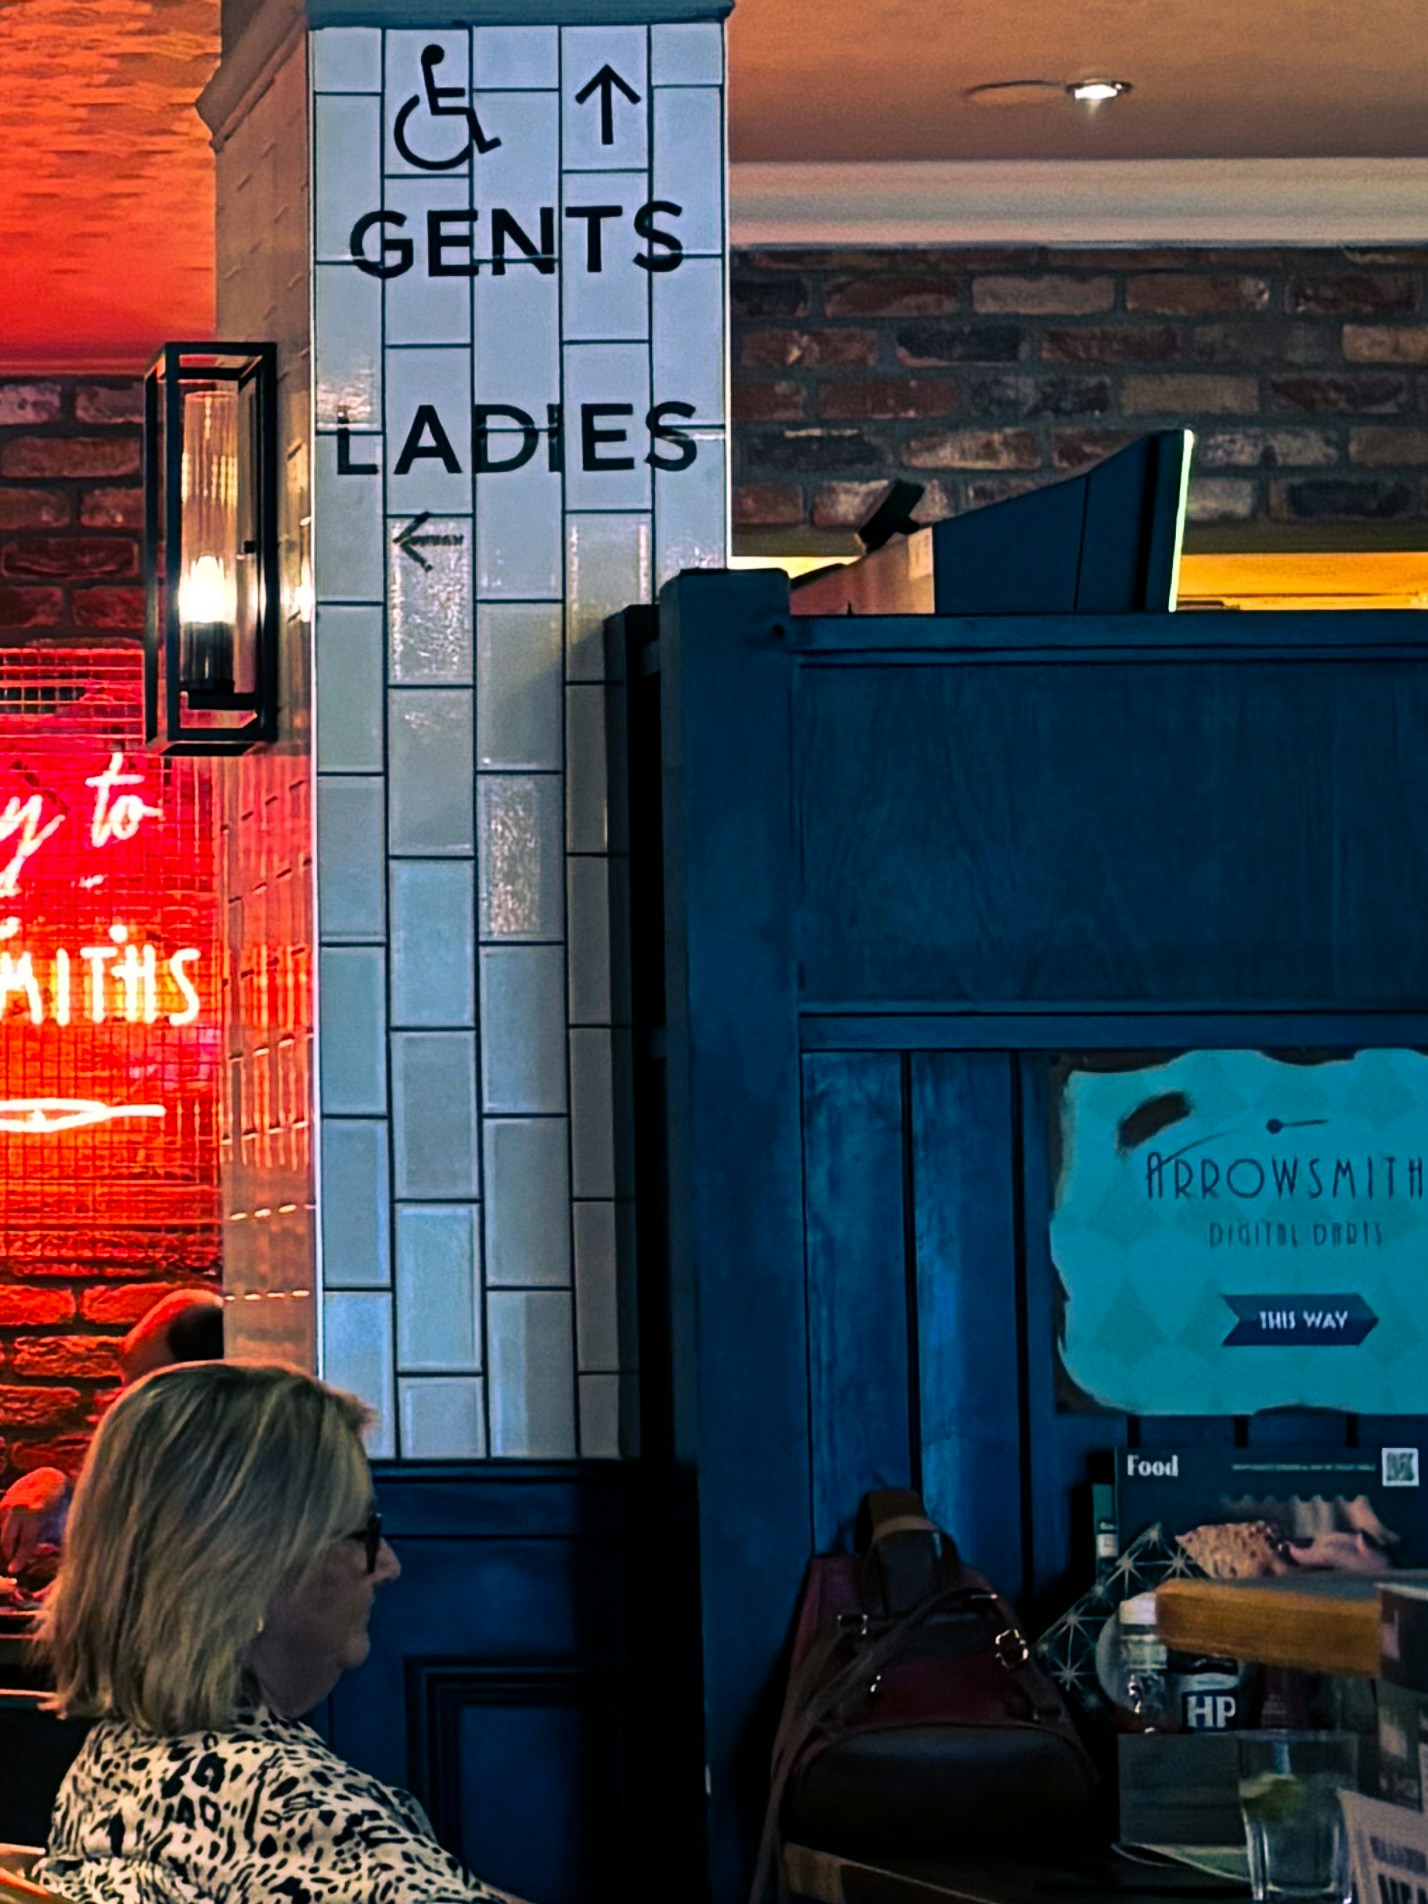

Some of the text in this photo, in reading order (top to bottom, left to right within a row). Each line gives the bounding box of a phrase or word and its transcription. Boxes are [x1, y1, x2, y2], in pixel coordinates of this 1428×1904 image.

[349, 201, 684, 278] GENTS
[336, 401, 699, 476] LADIES
[85, 752, 166, 846] to
[1145, 1152, 1425, 1200] ARROWSMITH
[1209, 1221, 1384, 1248] DIGITAL DARTS
[1258, 1309, 1349, 1330] THIS WAY
[1126, 1454, 1179, 1478] Food
[1187, 1695, 1237, 1729] HP
